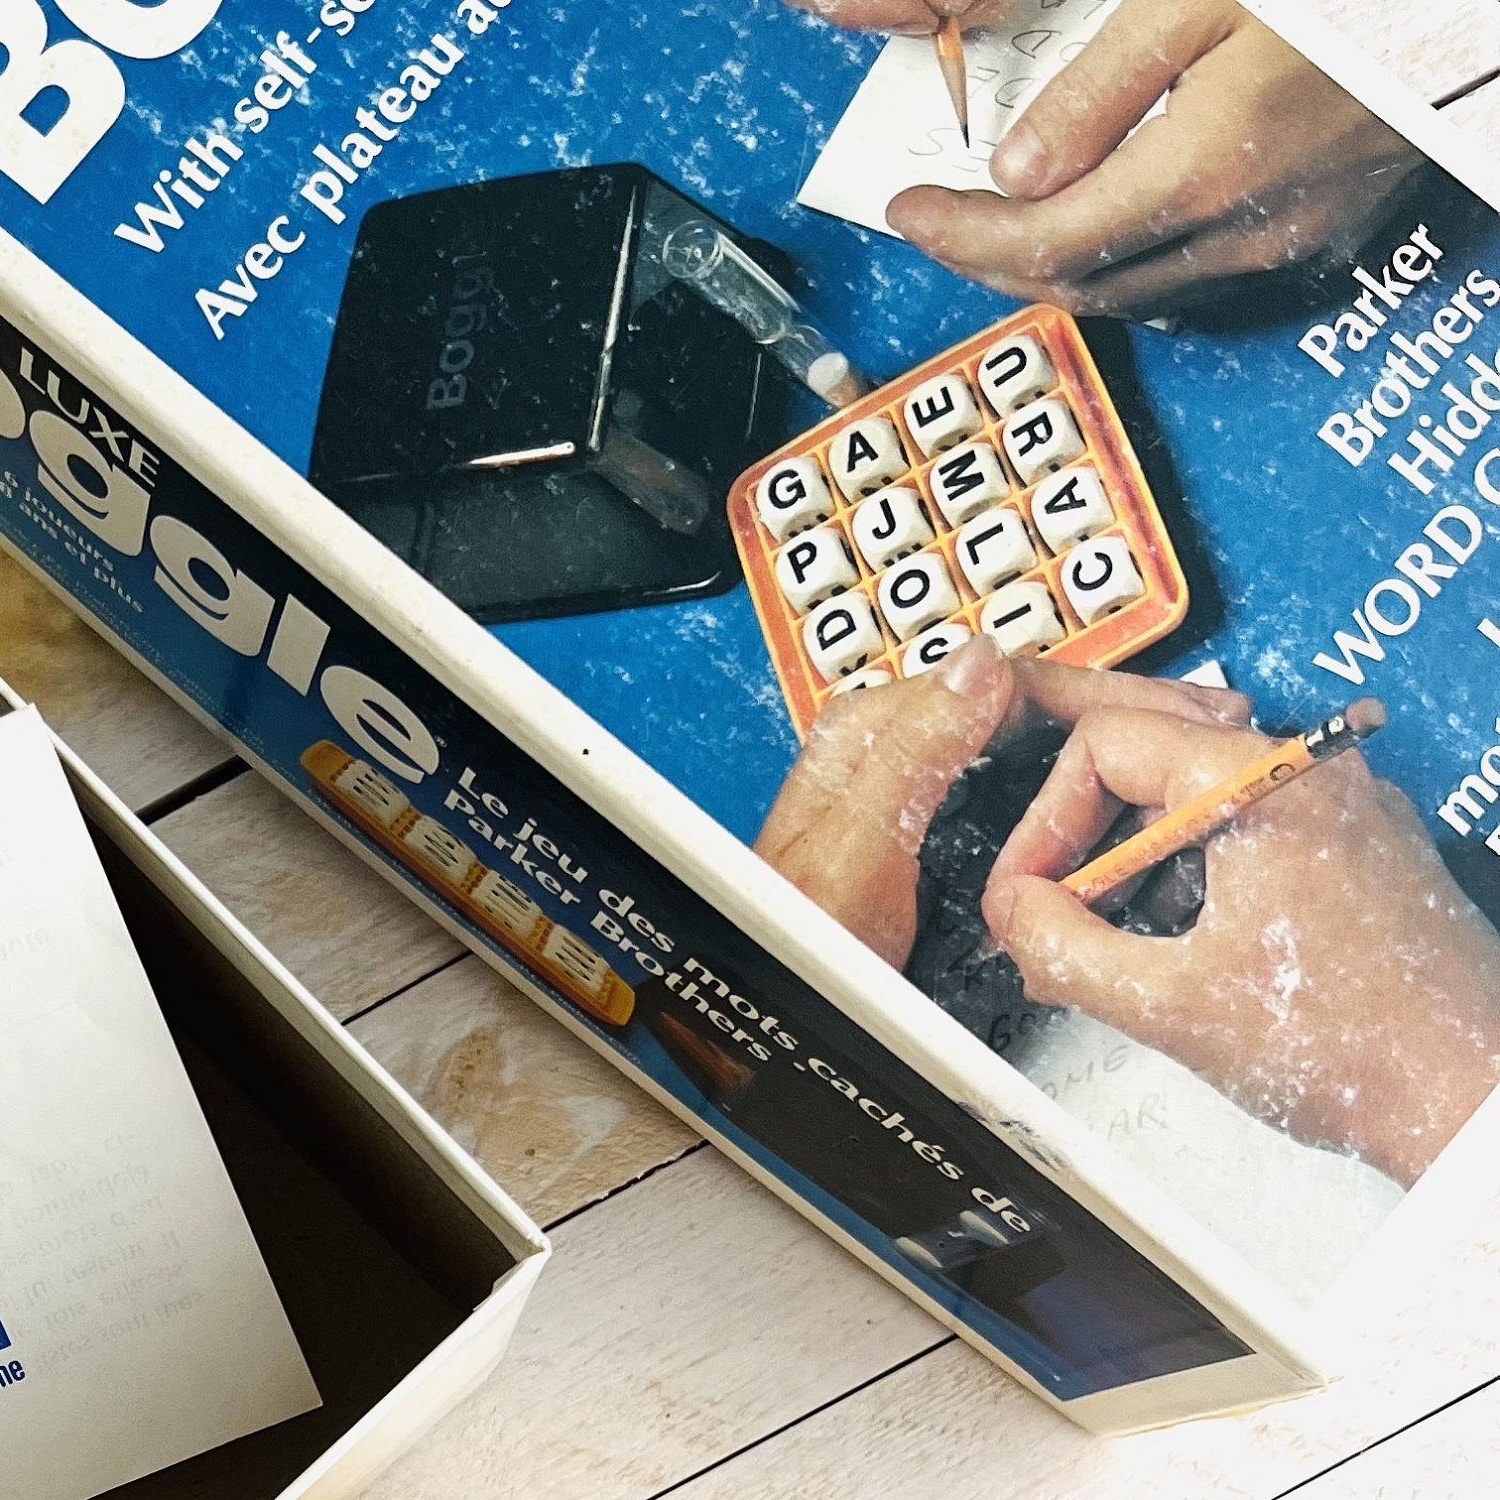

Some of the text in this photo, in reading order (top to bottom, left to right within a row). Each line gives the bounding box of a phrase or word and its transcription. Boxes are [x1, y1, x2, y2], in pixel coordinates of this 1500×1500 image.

[113, 129, 244, 253] With
[193, 215, 306, 341] Avec
[300, 31, 465, 226] plateau
[1297, 223, 1444, 379] Parker
[1316, 268, 1500, 468] Brothers
[19, 347, 160, 487] LUXE
[768, 346, 1027, 509] G A E U
[787, 541, 817, 584] P
[871, 498, 892, 540] J
[1011, 410, 1053, 457] R
[25, 486, 115, 573] joueurs
[93, 566, 143, 613] plus
[816, 476, 1088, 652] D O L A
[1072, 551, 1113, 592] C
[1312, 504, 1483, 685] WORD
[443, 788, 580, 906] Parker
[590, 910, 772, 1062] Brothers
[458, 766, 509, 819] Le
[513, 817, 588, 884] jeu
[598, 888, 675, 953] des
[683, 956, 799, 1051] mots
[971, 1187, 1030, 1233] de
